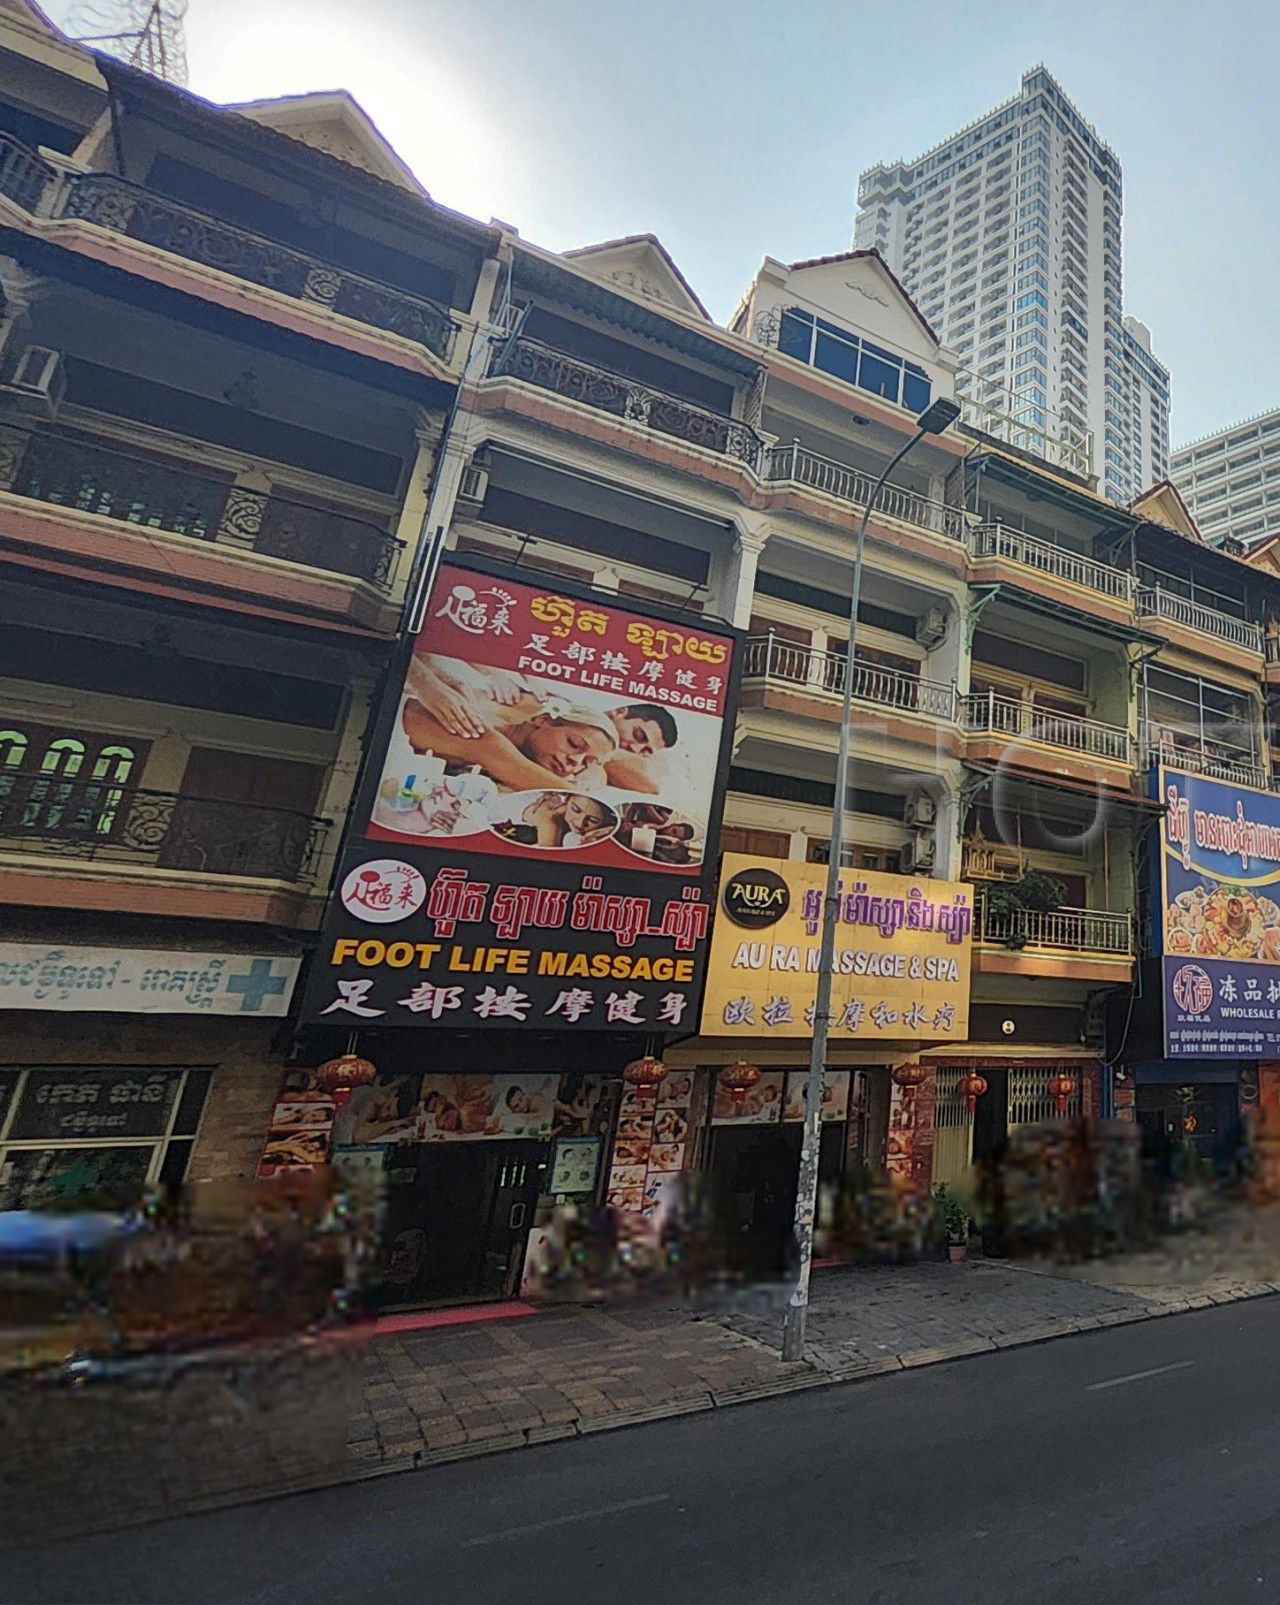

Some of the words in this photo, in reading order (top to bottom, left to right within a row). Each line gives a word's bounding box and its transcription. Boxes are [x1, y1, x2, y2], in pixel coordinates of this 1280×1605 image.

[518, 655, 576, 680] FOOT
[580, 670, 624, 691] LIFE
[628, 681, 718, 712] MASSAGE
[523, 633, 723, 695] 足部按摩健身
[731, 882, 786, 907] AURA
[331, 939, 441, 969] FOOT
[448, 945, 531, 975] LIFE
[537, 951, 695, 982] MASSAGE
[909, 957, 922, 980] &
[923, 957, 960, 982] SPA
[319, 979, 689, 1025] 足部按摩健身
[1219, 1006, 1275, 1020] WHOLESALE
